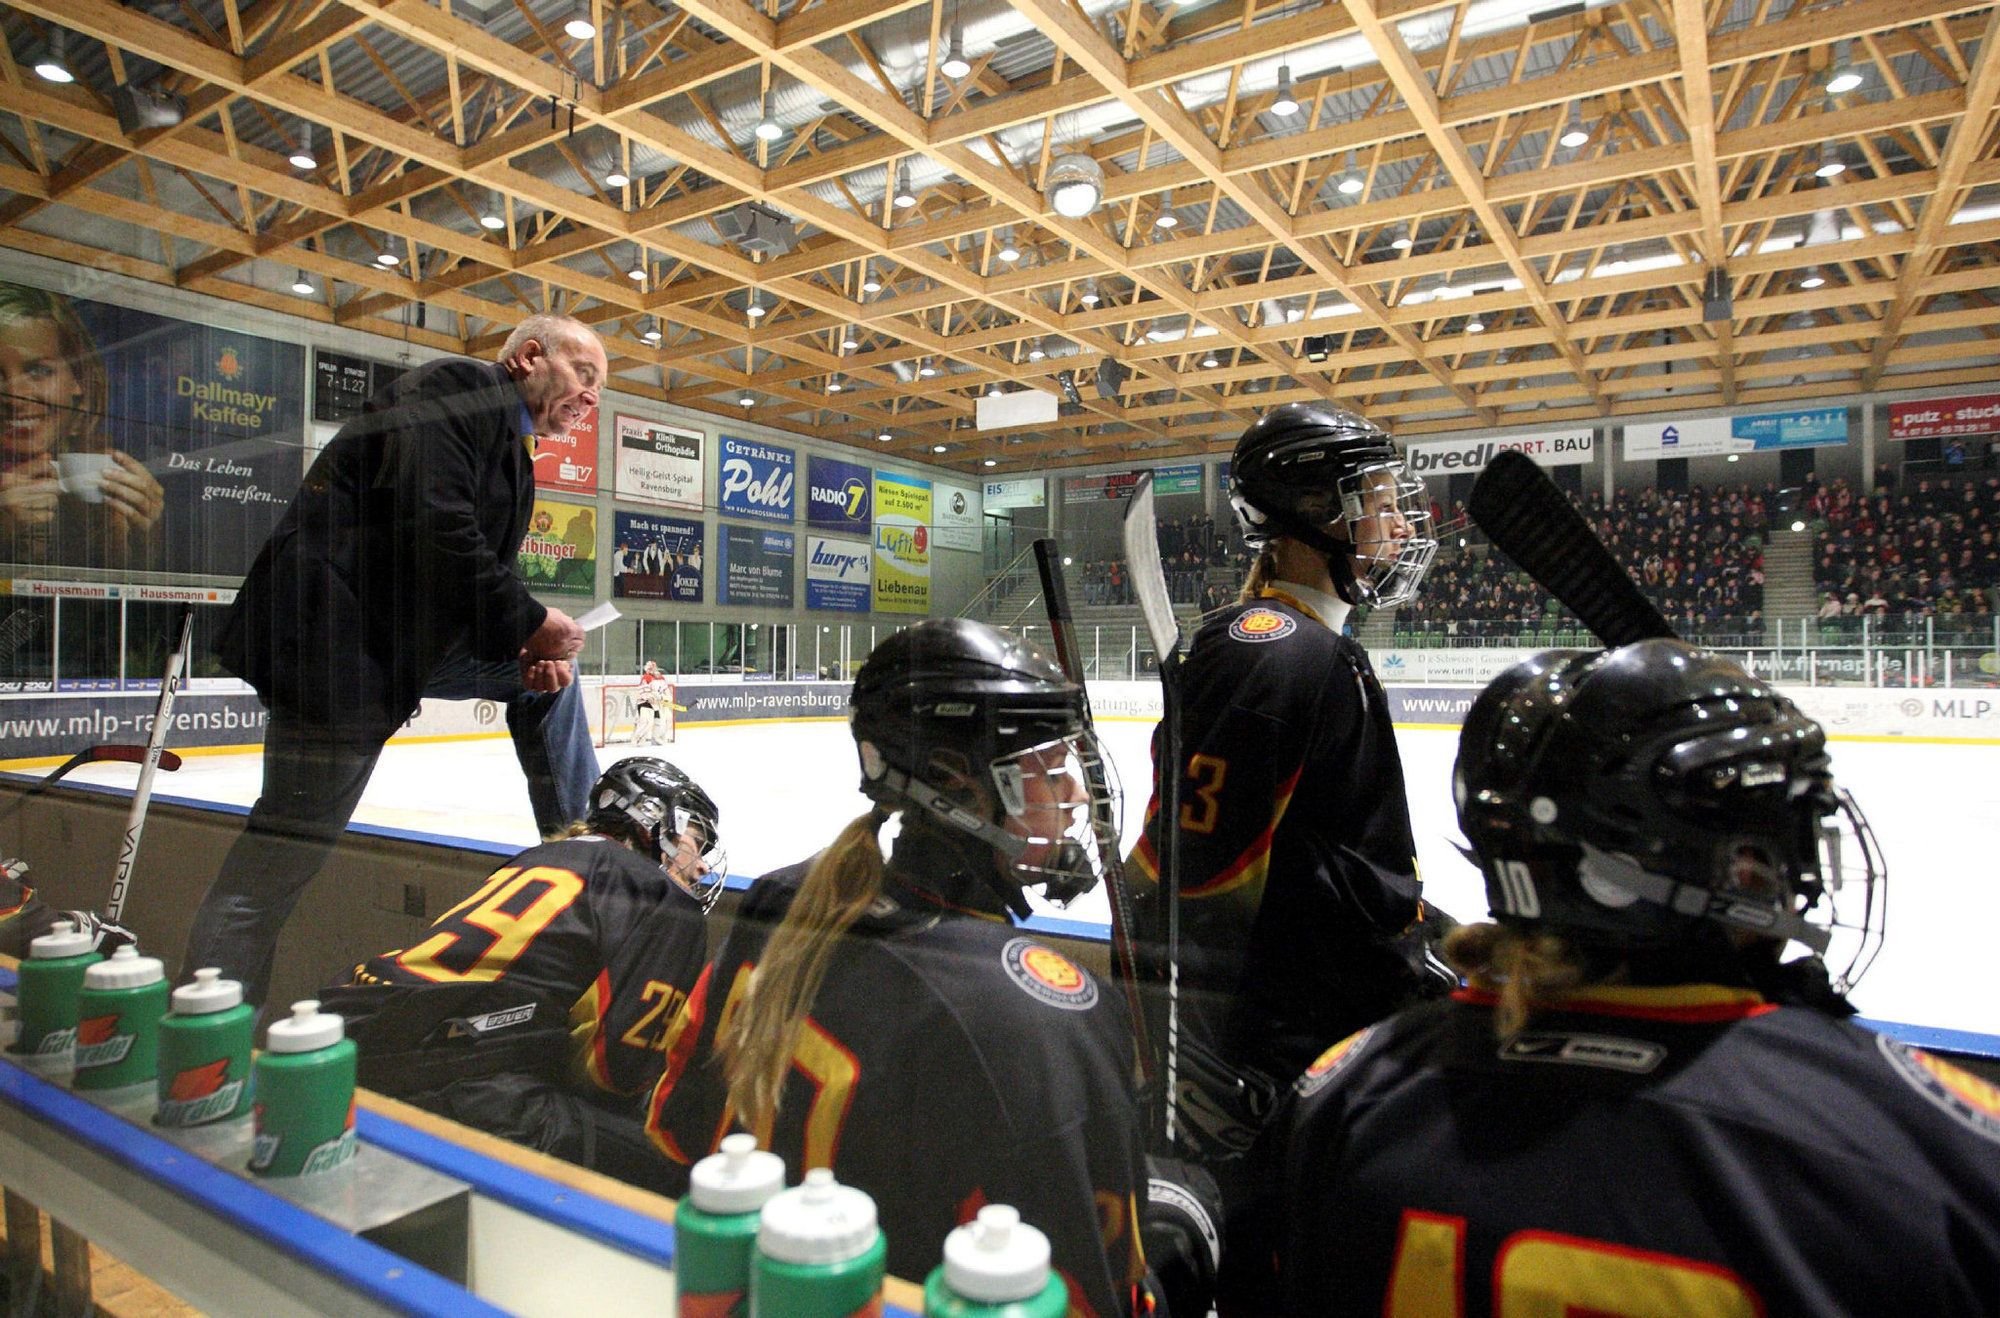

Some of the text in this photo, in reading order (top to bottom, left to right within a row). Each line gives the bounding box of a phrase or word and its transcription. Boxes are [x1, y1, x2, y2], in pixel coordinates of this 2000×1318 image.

[177, 375, 277, 413] Dallmayr
[193, 401, 262, 428] Kaffee
[1903, 410, 1940, 427] putz
[622, 425, 643, 437] Praxis
[655, 432, 676, 443] Klinik
[655, 442, 696, 457] Orthopädie
[726, 440, 792, 464] GETRÄNKE
[1410, 443, 1495, 471] bredl
[168, 452, 253, 477] Das Leben
[640, 481, 682, 497] Ravensburg
[722, 458, 794, 508] Pohl
[811, 485, 865, 516] RADIO 7
[630, 520, 694, 536] Mach es spannend!
[876, 526, 914, 553] Lufti
[729, 563, 783, 578] Marc von Blume
[32, 583, 105, 596] Haussmann
[140, 588, 204, 600] Haussmann
[878, 579, 928, 595] Liebenau
[1932, 699, 1991, 719] MLP
